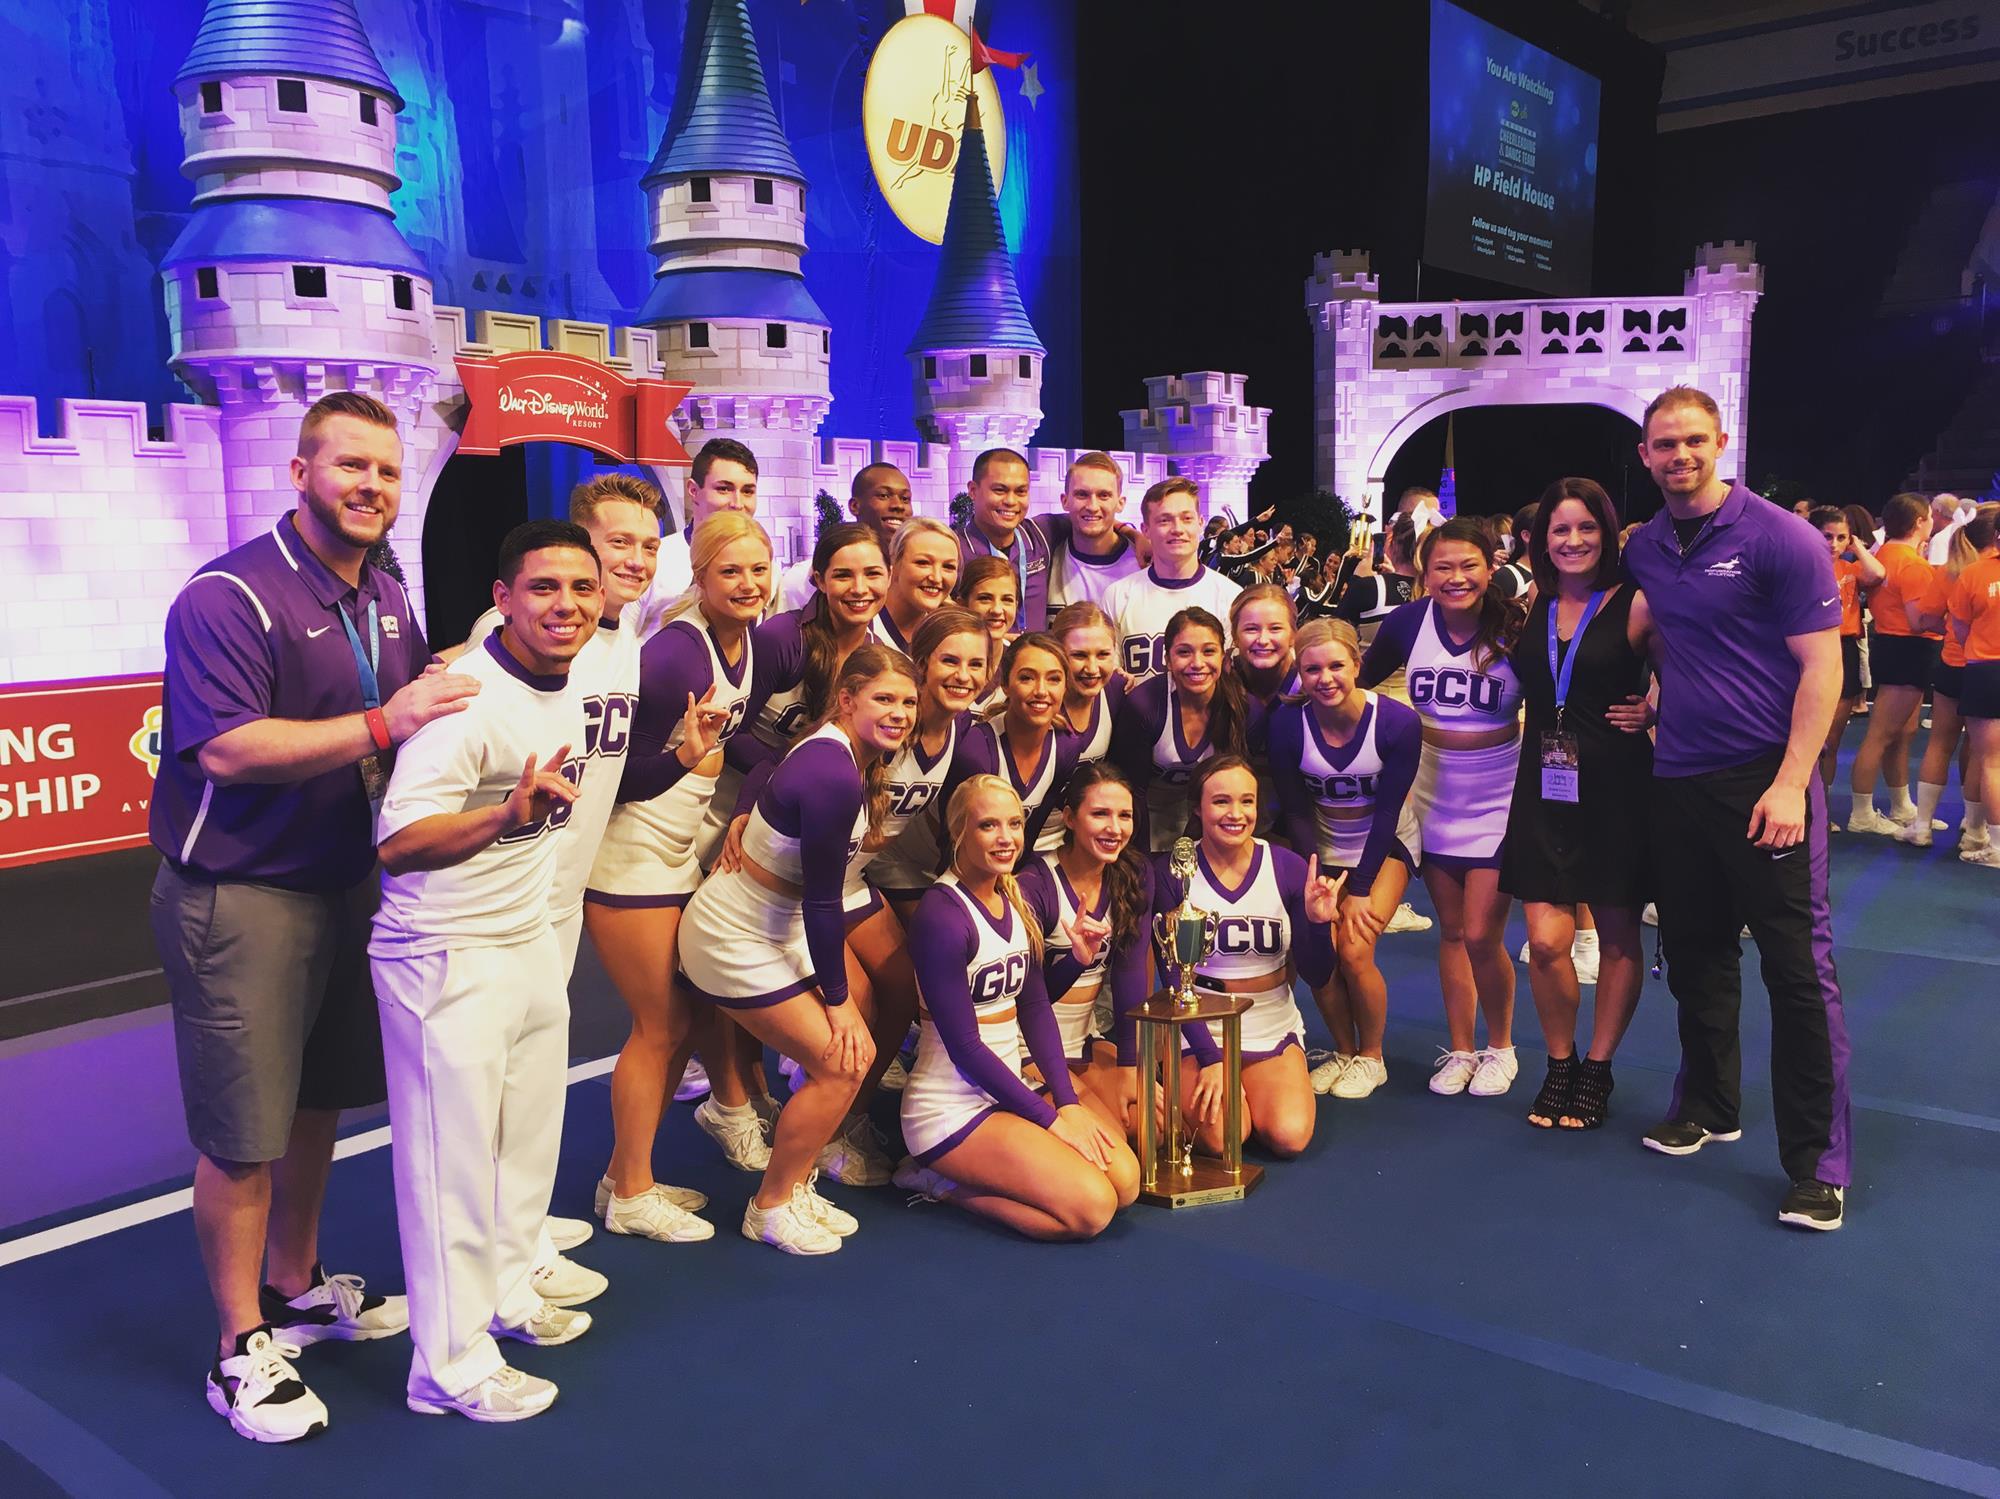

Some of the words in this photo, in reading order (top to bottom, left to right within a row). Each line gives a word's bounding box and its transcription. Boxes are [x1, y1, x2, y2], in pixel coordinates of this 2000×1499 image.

[1834, 14, 1980, 61] Success
[1487, 56, 1501, 78] You
[1502, 65, 1517, 84] Are
[1518, 72, 1554, 105] Watching
[886, 118, 956, 174] UD
[1473, 164, 1492, 188] HP
[1492, 171, 1521, 199] Field
[1522, 181, 1555, 210] House
[1472, 216, 1490, 230] Follow
[1497, 225, 1508, 236] and
[1508, 227, 1517, 241] tag
[572, 420, 603, 429] RESORT
[573, 400, 605, 419] World
[1122, 632, 1168, 678] GC
[1408, 666, 1506, 715] GCU
[970, 950, 1030, 1006] GC
